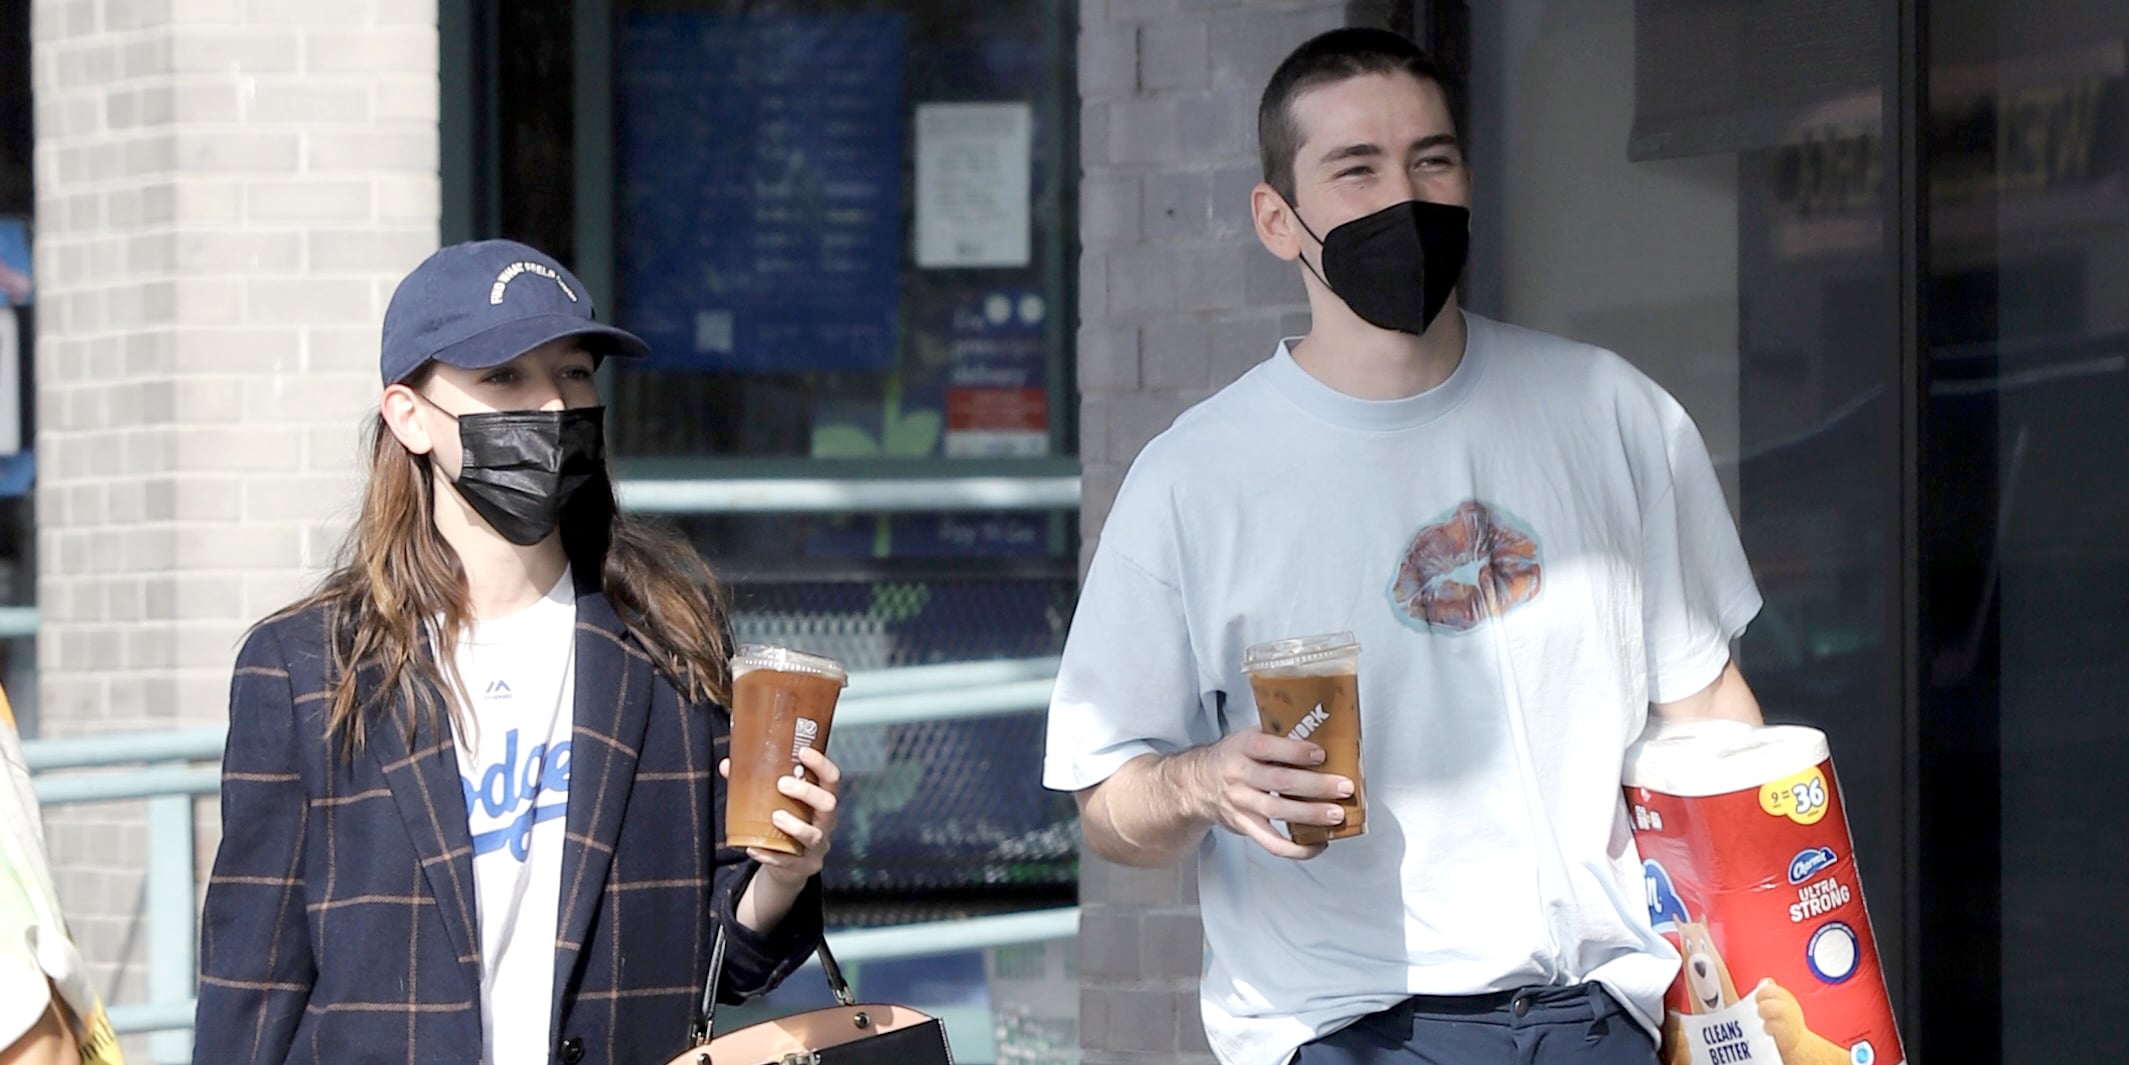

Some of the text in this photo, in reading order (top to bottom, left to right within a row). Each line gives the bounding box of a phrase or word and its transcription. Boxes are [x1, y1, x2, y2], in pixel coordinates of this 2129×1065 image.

[1770, 791, 1779, 804] 9
[1791, 776, 1826, 815] 36
[1797, 876, 1838, 902] ULTRA
[1789, 885, 1851, 923] STRONG
[1702, 1019, 1743, 1046] CLEANS
[1708, 1040, 1752, 1065] BETTER
